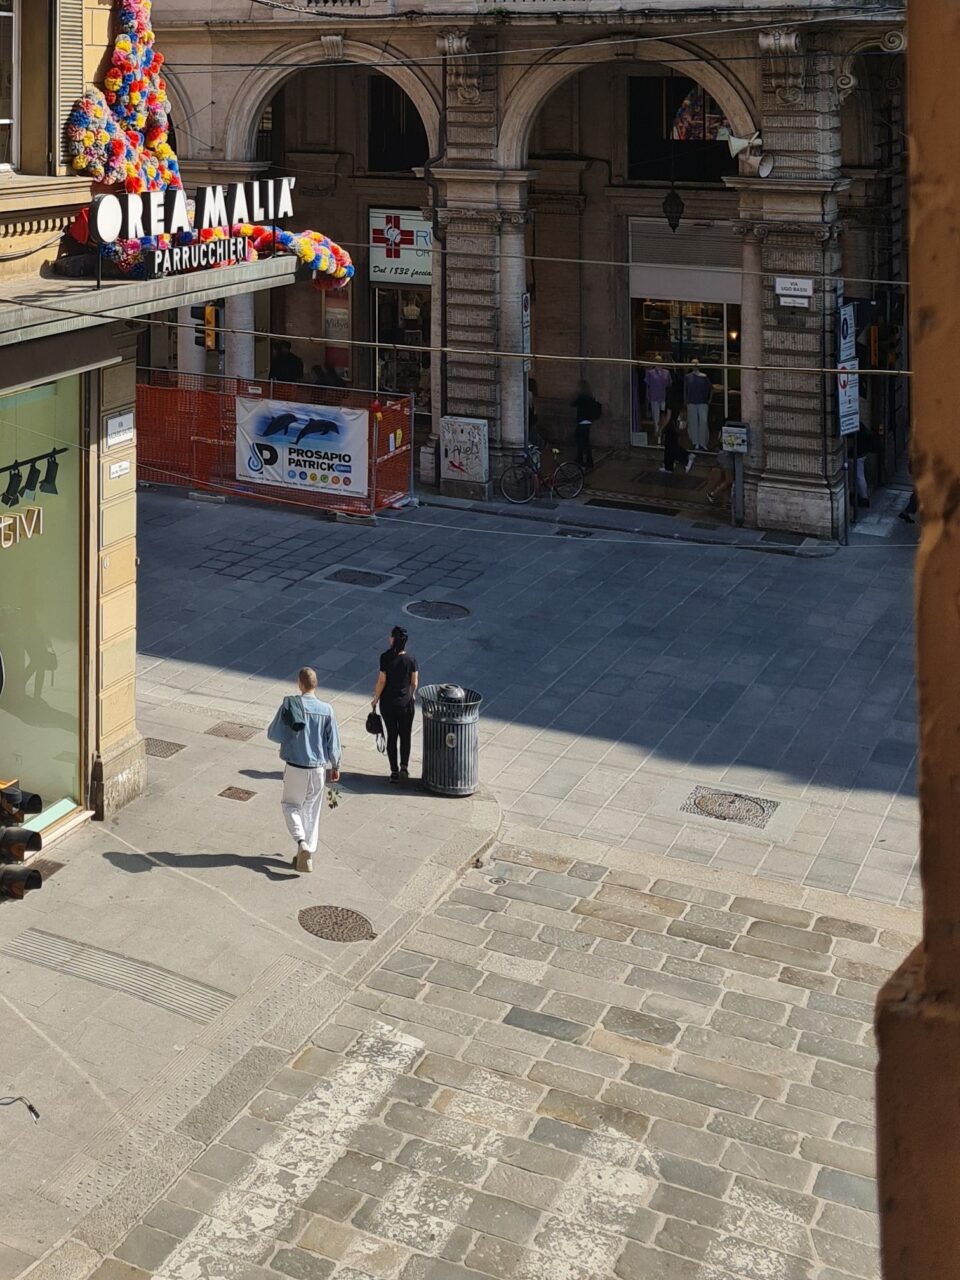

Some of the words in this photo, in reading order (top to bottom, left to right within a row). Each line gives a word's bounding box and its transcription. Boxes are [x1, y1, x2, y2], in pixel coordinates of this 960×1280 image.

[95, 190, 190, 242] OREA
[154, 236, 249, 274] PARRUCCHIERI
[288, 447, 352, 463] PROSAPIO
[288, 458, 336, 472] PATRICK
